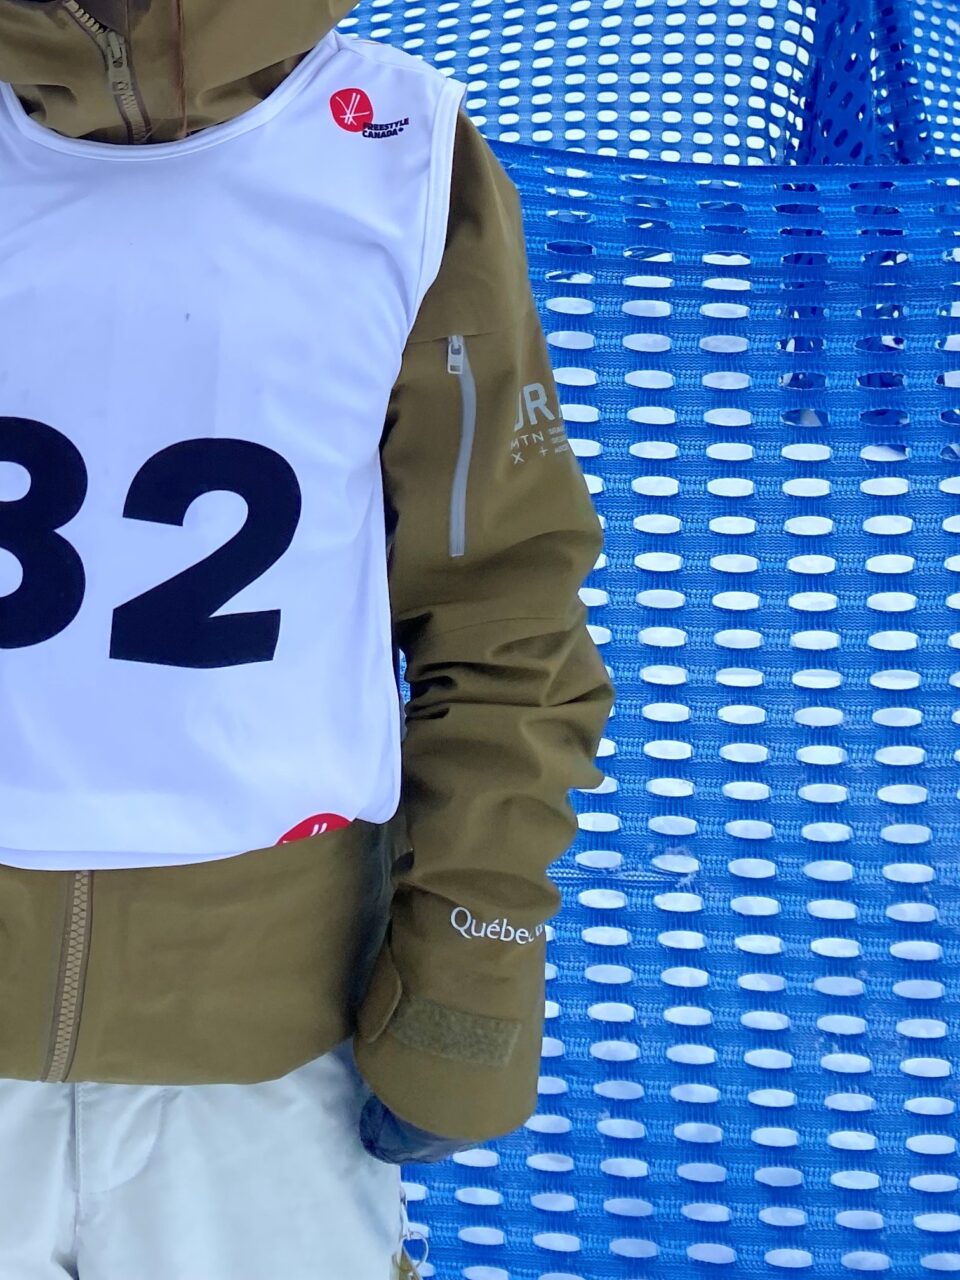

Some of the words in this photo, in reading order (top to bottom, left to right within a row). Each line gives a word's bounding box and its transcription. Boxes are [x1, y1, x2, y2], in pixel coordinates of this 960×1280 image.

[362, 117, 409, 131] FREESTYLE
[362, 128, 398, 139] CANADA
[510, 431, 545, 450] MTN
